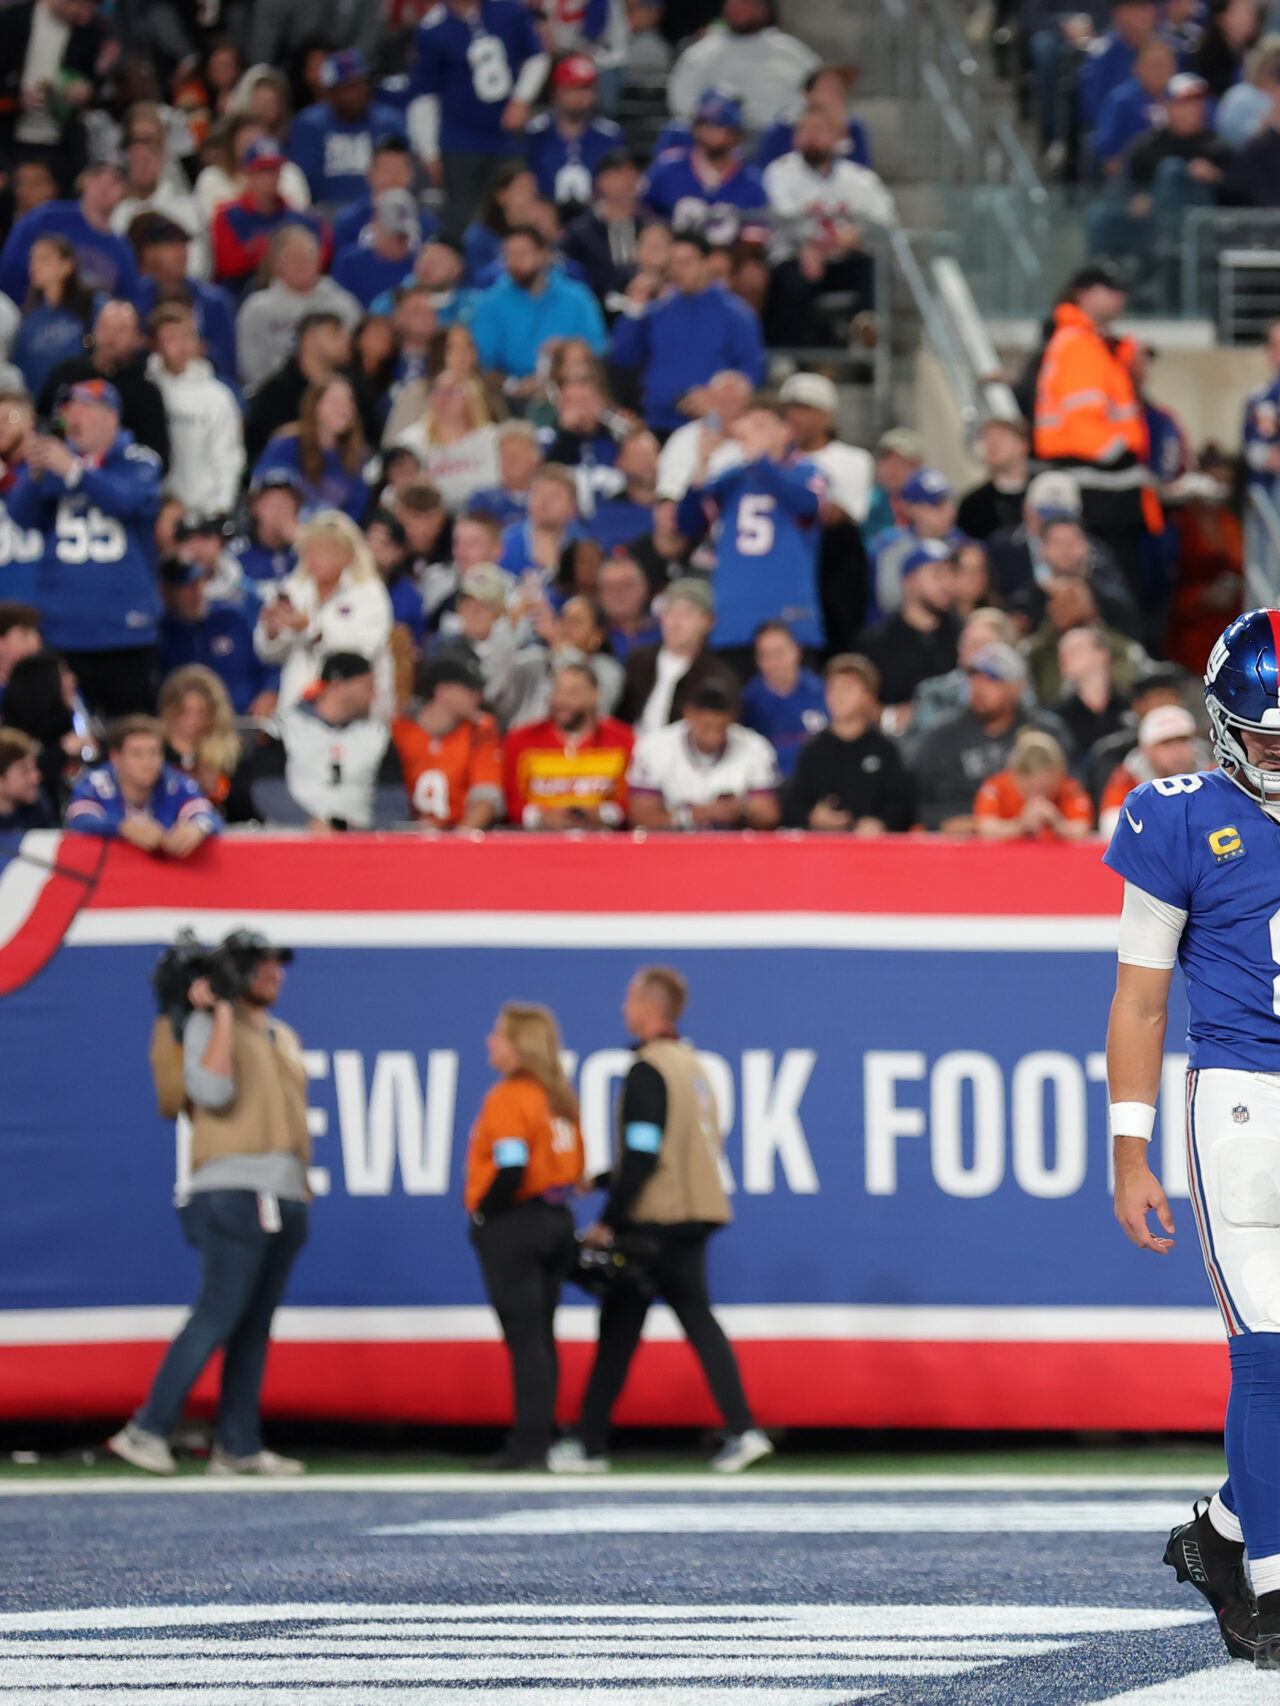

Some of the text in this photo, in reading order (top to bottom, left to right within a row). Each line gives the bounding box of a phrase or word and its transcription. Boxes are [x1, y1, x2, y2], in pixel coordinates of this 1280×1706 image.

[466, 34, 513, 103] 8
[56, 497, 127, 564] 55
[736, 493, 776, 556] 5
[1151, 775, 1204, 797] 8
[1208, 827, 1242, 856] C
[558, 1048, 820, 1196] OK
[1181, 1539, 1209, 1583] NIKE
